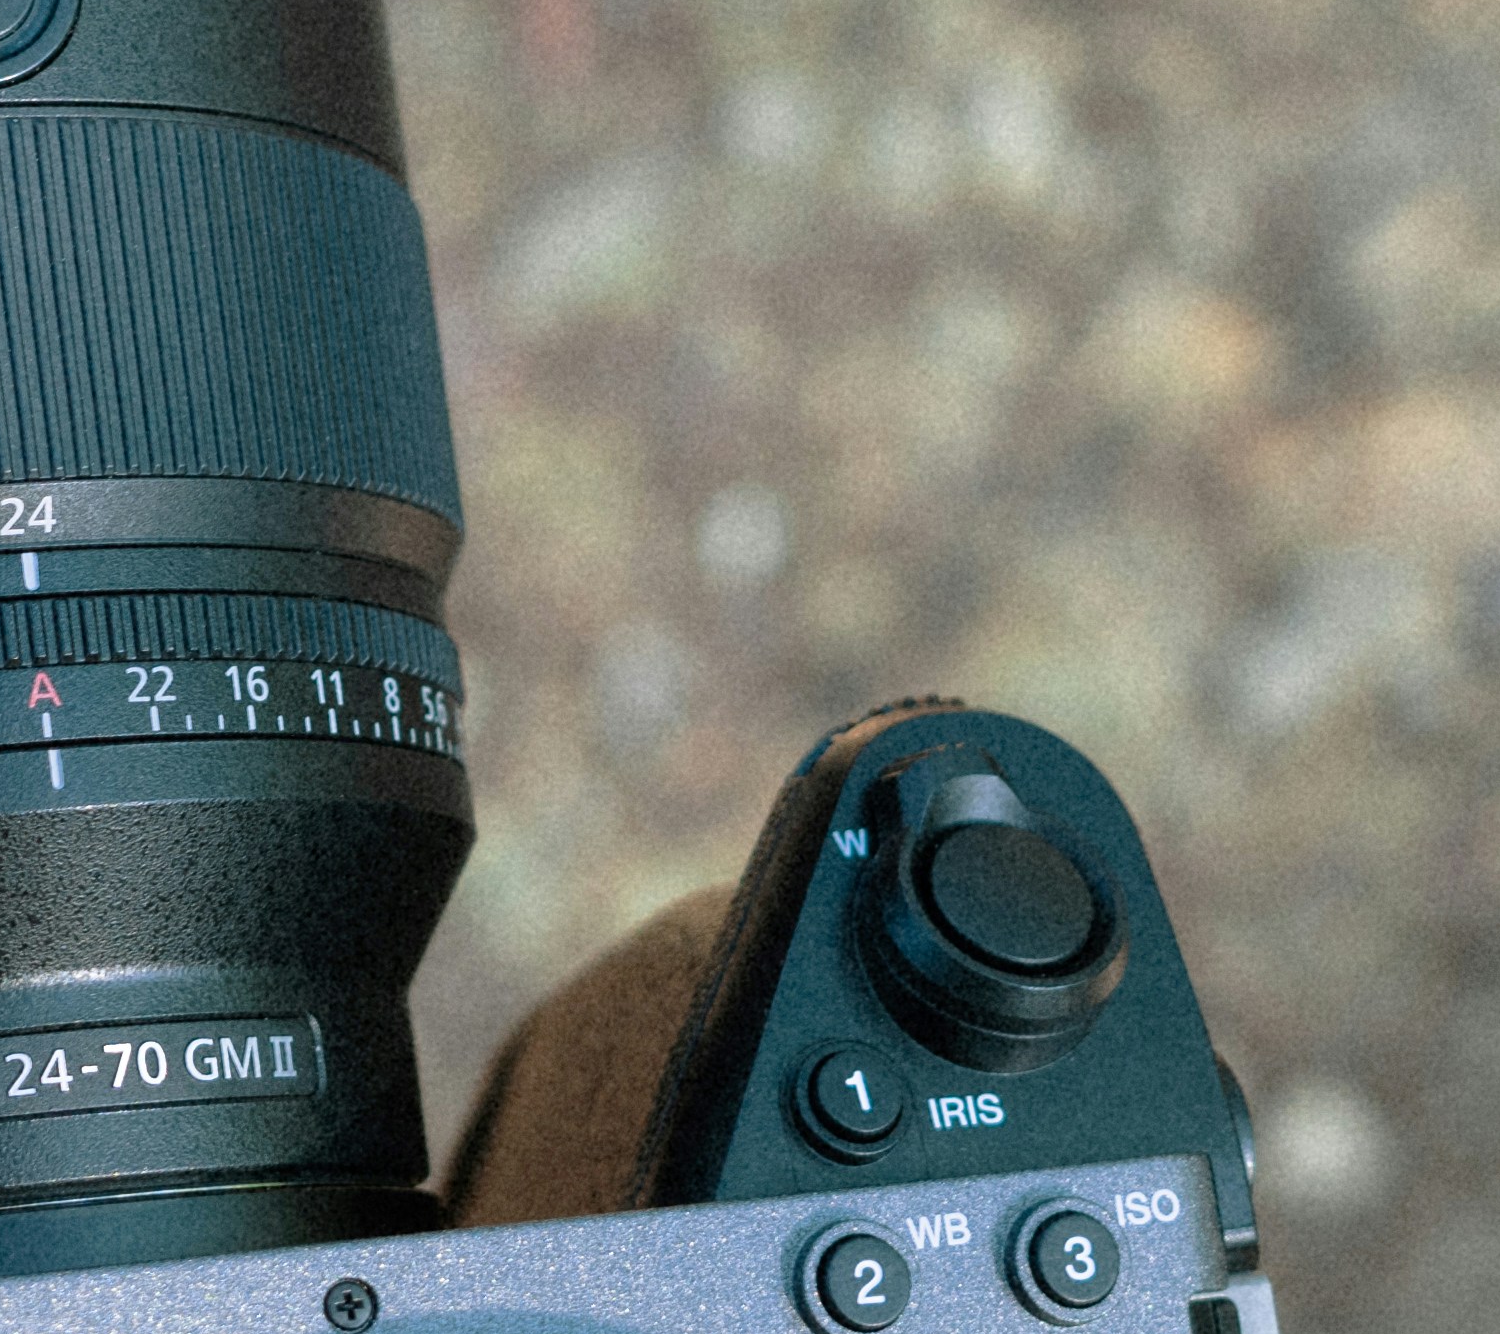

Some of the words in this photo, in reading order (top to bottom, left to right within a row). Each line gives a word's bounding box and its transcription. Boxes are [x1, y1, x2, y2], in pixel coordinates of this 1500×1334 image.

[0, 495, 57, 536] 24
[28, 672, 63, 709] A
[126, 665, 177, 703] 22
[225, 665, 270, 702] 16
[310, 668, 344, 706] 11
[383, 677, 401, 714] 8
[832, 828, 868, 858] W
[844, 1070, 871, 1111] 1
[928, 1093, 1005, 1129] IRIS
[1115, 1188, 1181, 1226] ISO
[906, 1212, 972, 1250] WB
[1063, 1235, 1097, 1281] 3
[852, 1258, 886, 1306] 2
